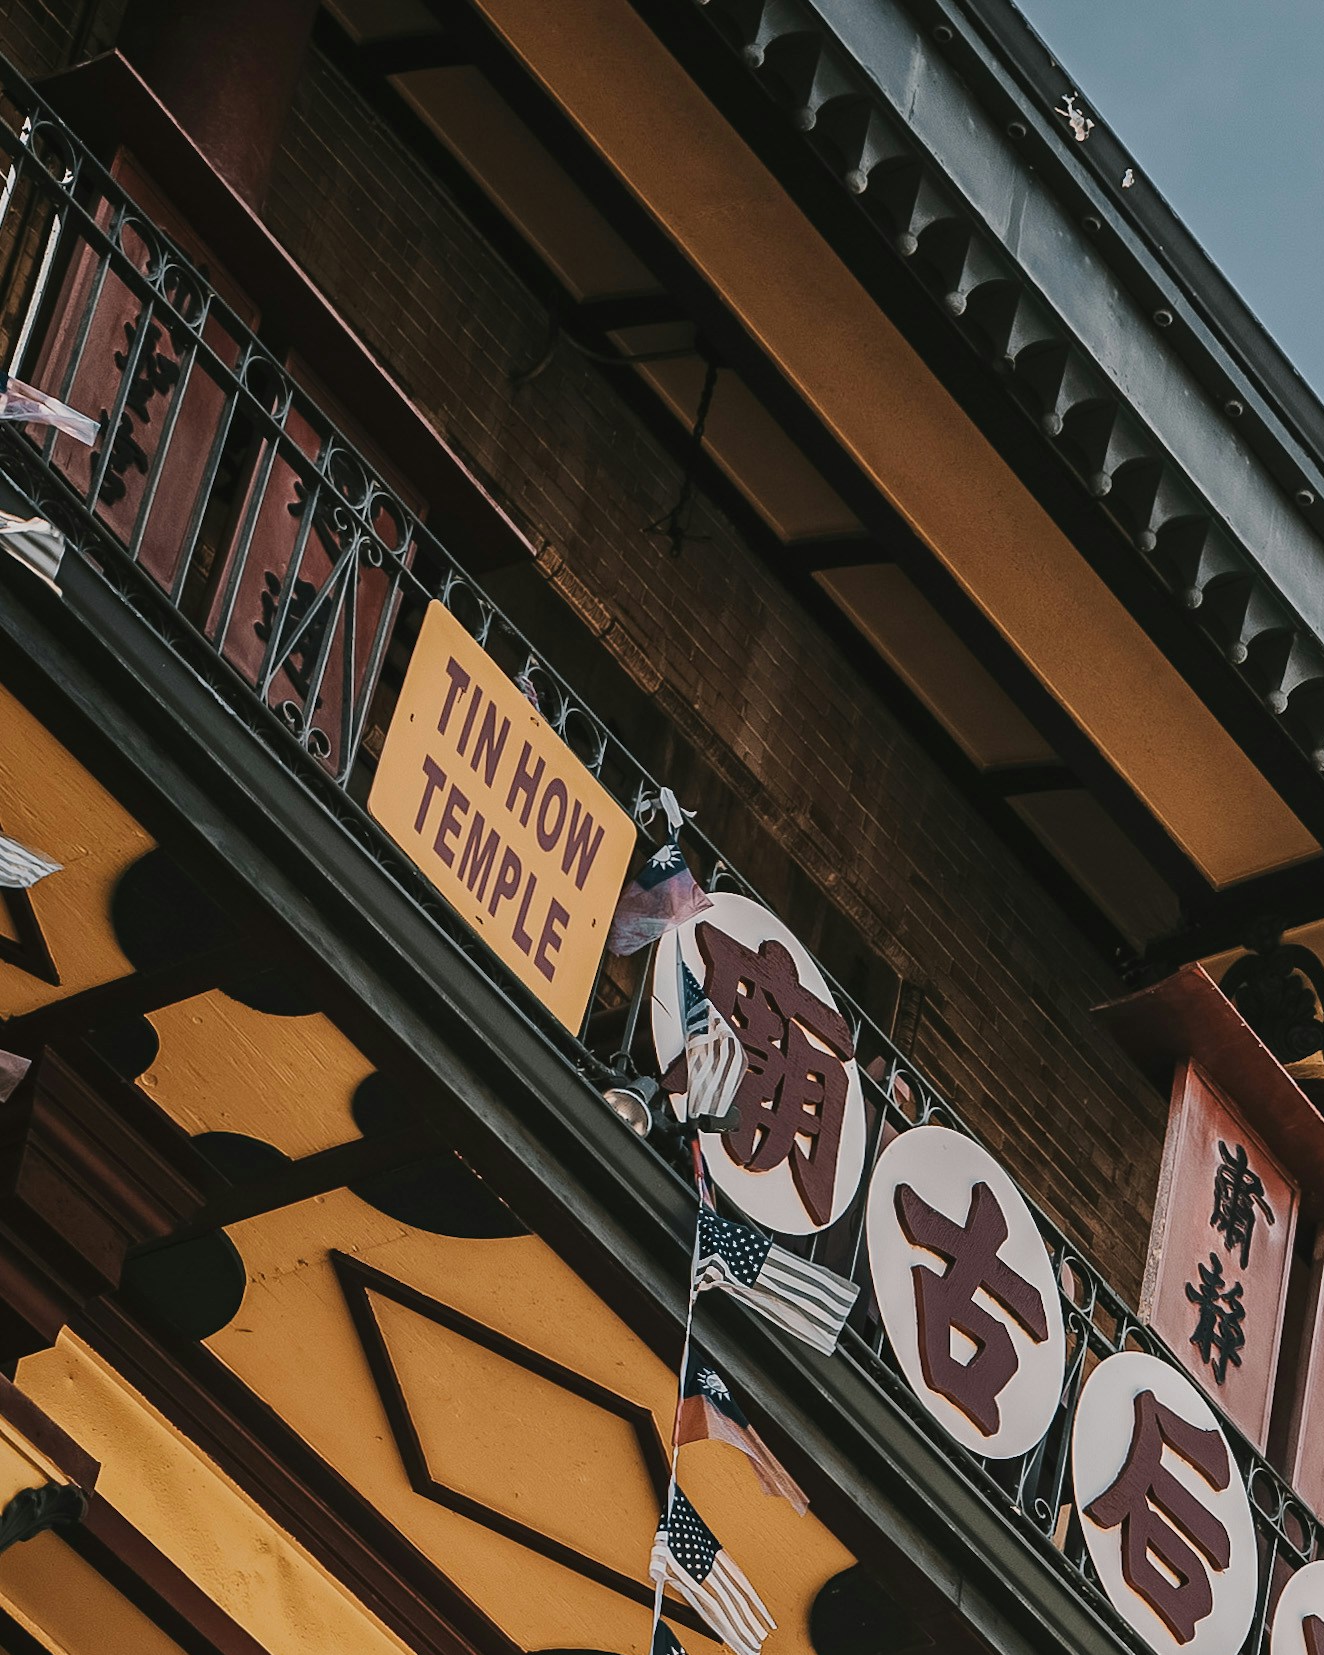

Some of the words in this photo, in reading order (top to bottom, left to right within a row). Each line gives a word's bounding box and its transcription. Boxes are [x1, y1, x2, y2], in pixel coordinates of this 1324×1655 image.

[414, 753, 570, 983] TEMPLE
[438, 655, 511, 789] TIN
[505, 741, 605, 891] HOW
